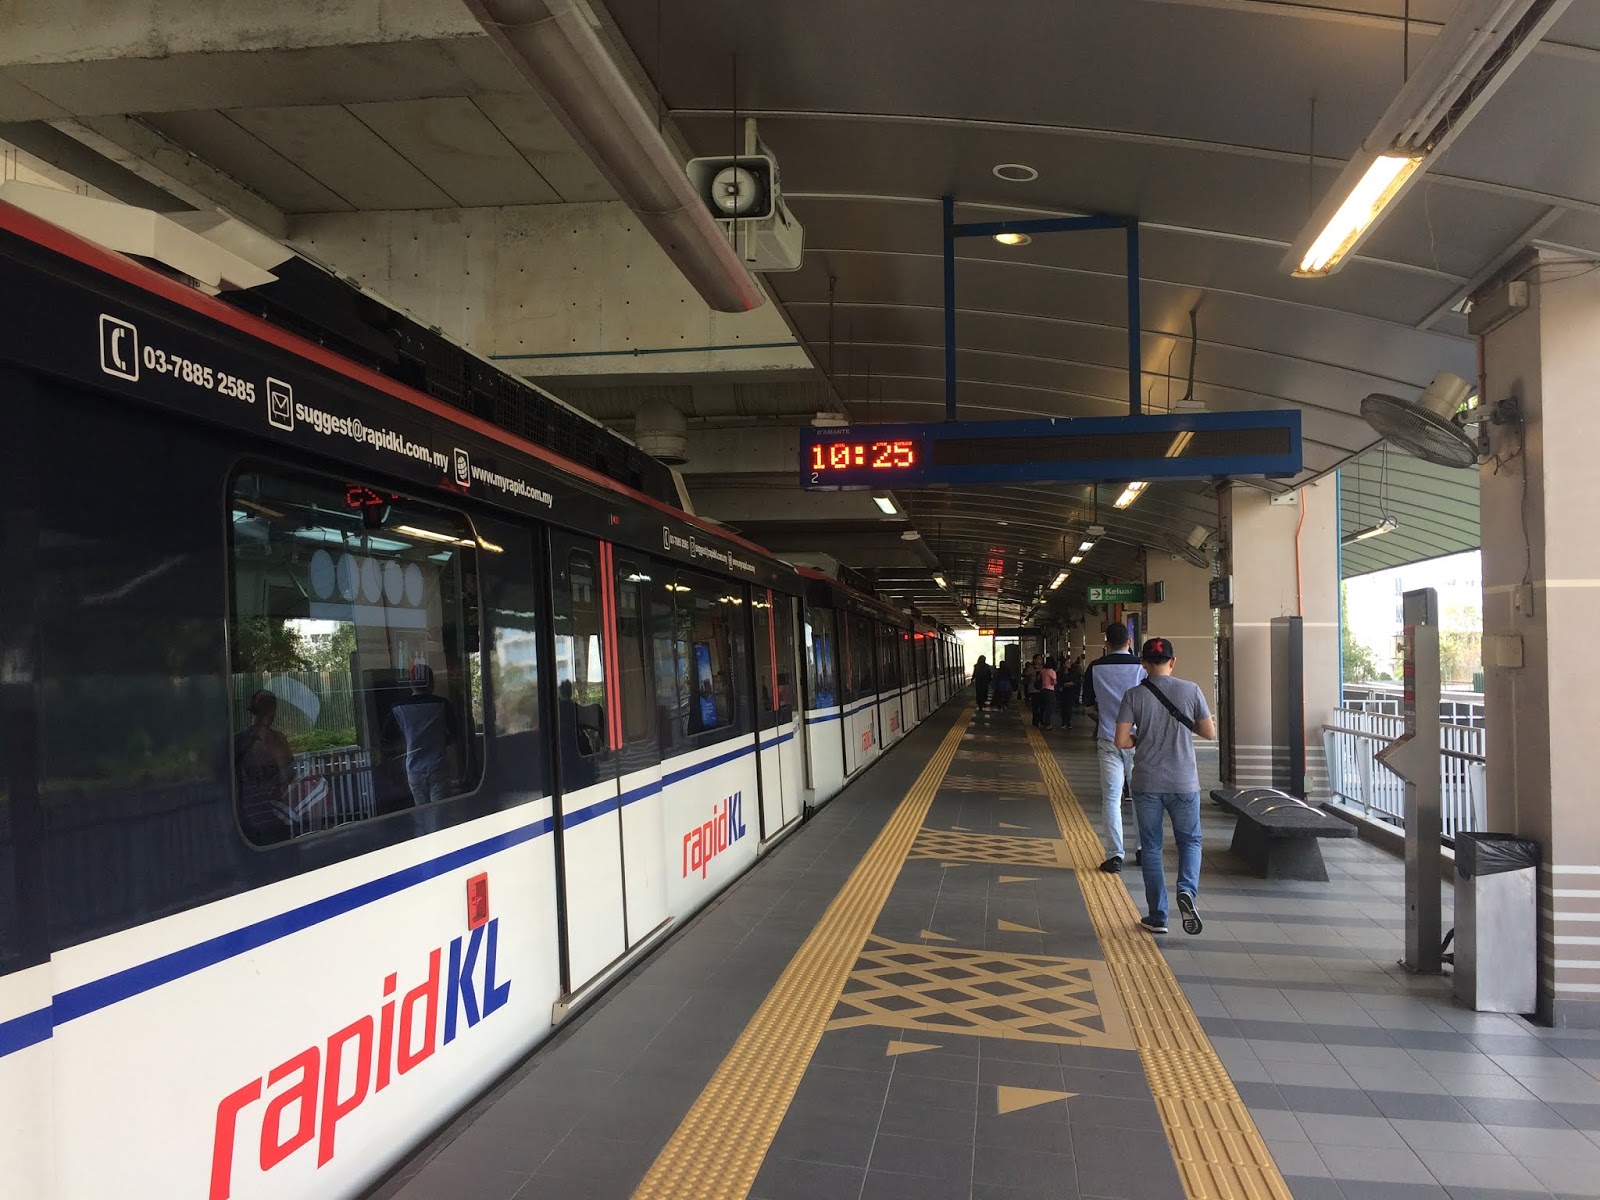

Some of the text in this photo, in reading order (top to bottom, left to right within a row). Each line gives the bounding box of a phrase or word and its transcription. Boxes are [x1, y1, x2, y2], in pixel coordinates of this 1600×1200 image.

[143, 345, 256, 404] 03-7885 2585
[295, 401, 450, 474] suggest@rapidkl.com.my
[812, 441, 914, 470] 10:25
[471, 465, 554, 509] www.myrapid.com.my
[811, 472, 819, 484] 2
[1105, 587, 1134, 595] Keluar
[682, 790, 746, 880] rapidKL
[209, 917, 512, 1200] rapidKL
